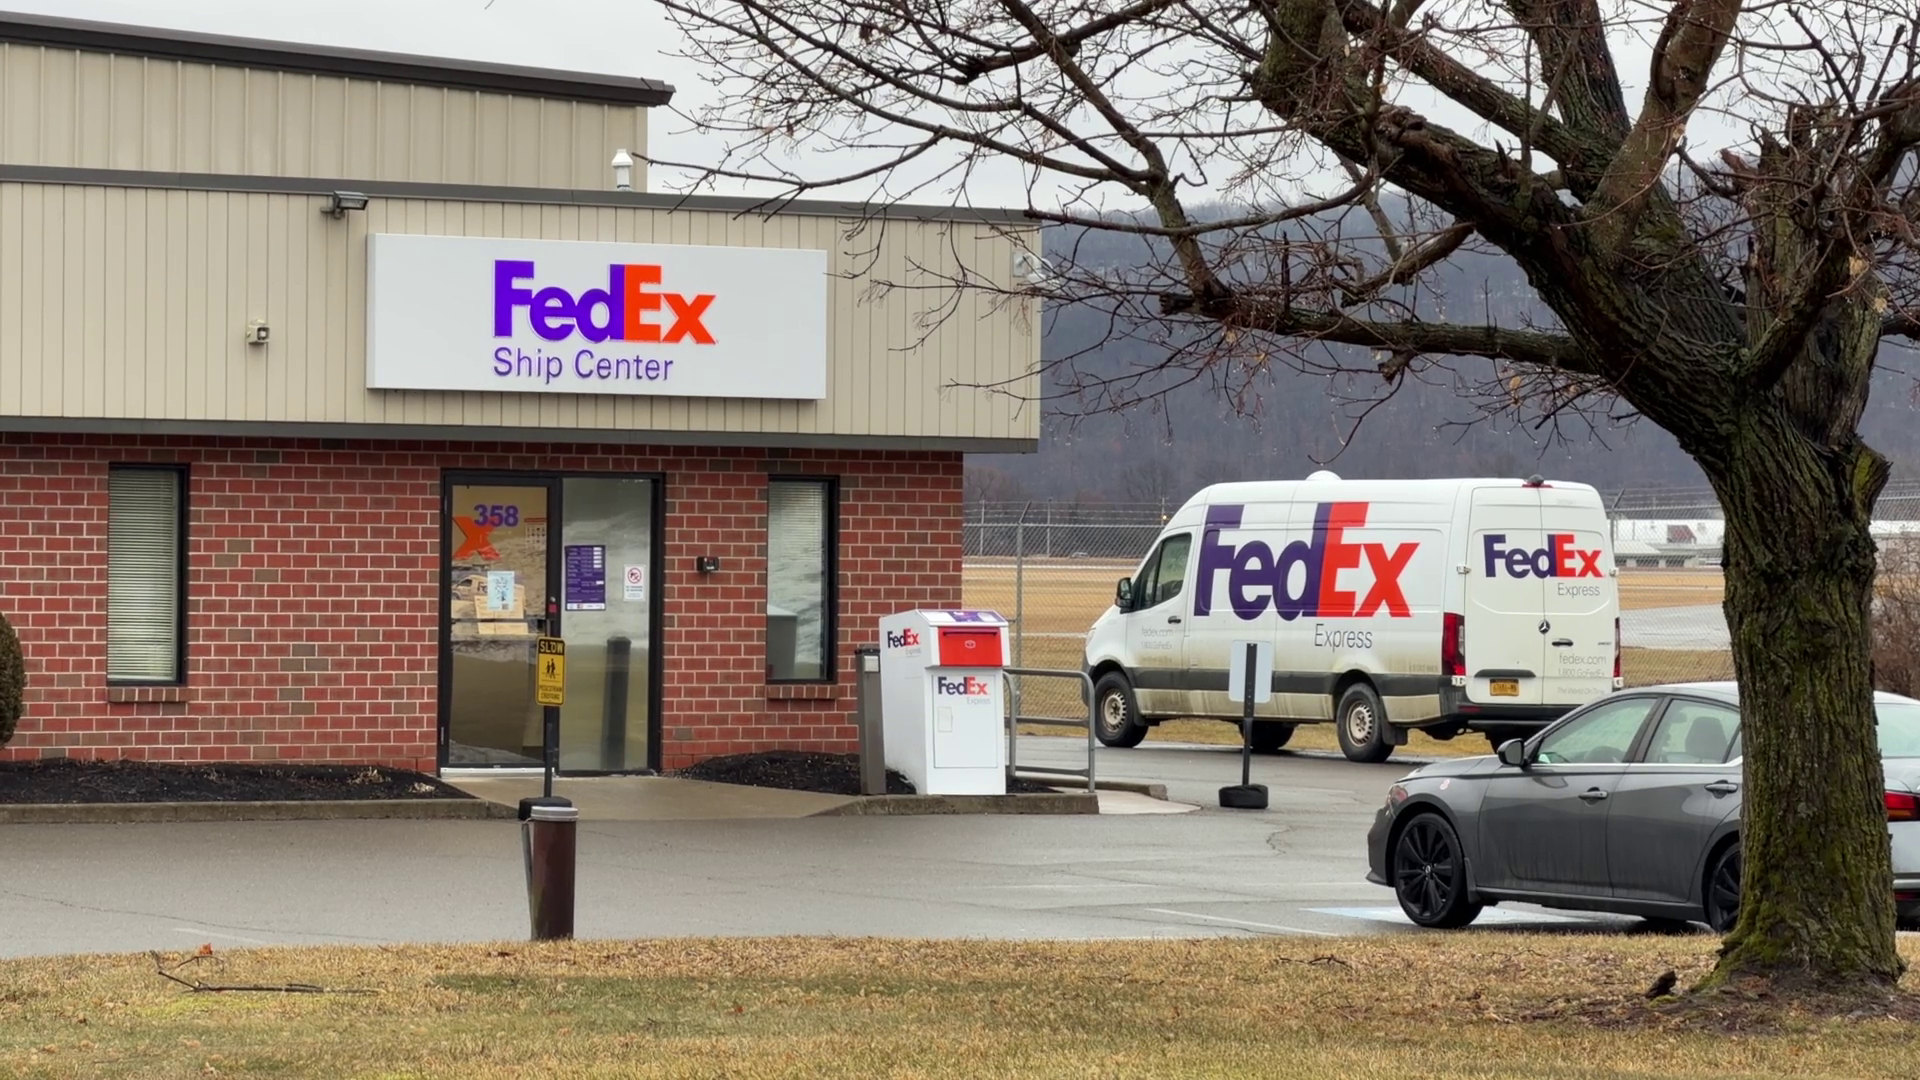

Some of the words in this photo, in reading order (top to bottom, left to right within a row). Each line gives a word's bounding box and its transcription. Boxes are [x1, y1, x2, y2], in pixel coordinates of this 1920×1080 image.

[493, 259, 717, 345] FedEx
[493, 346, 564, 384] Ship
[573, 349, 674, 381] Center
[474, 504, 519, 527] 358
[1194, 501, 1421, 621] FedEx
[1483, 534, 1604, 579] FedEx
[1557, 582, 1601, 598] Express
[540, 641, 564, 654] SLOW
[887, 628, 919, 648] FedEx
[1315, 623, 1373, 653] Express
[1559, 652, 1607, 665] fedex.com
[938, 676, 988, 696] FedEx
